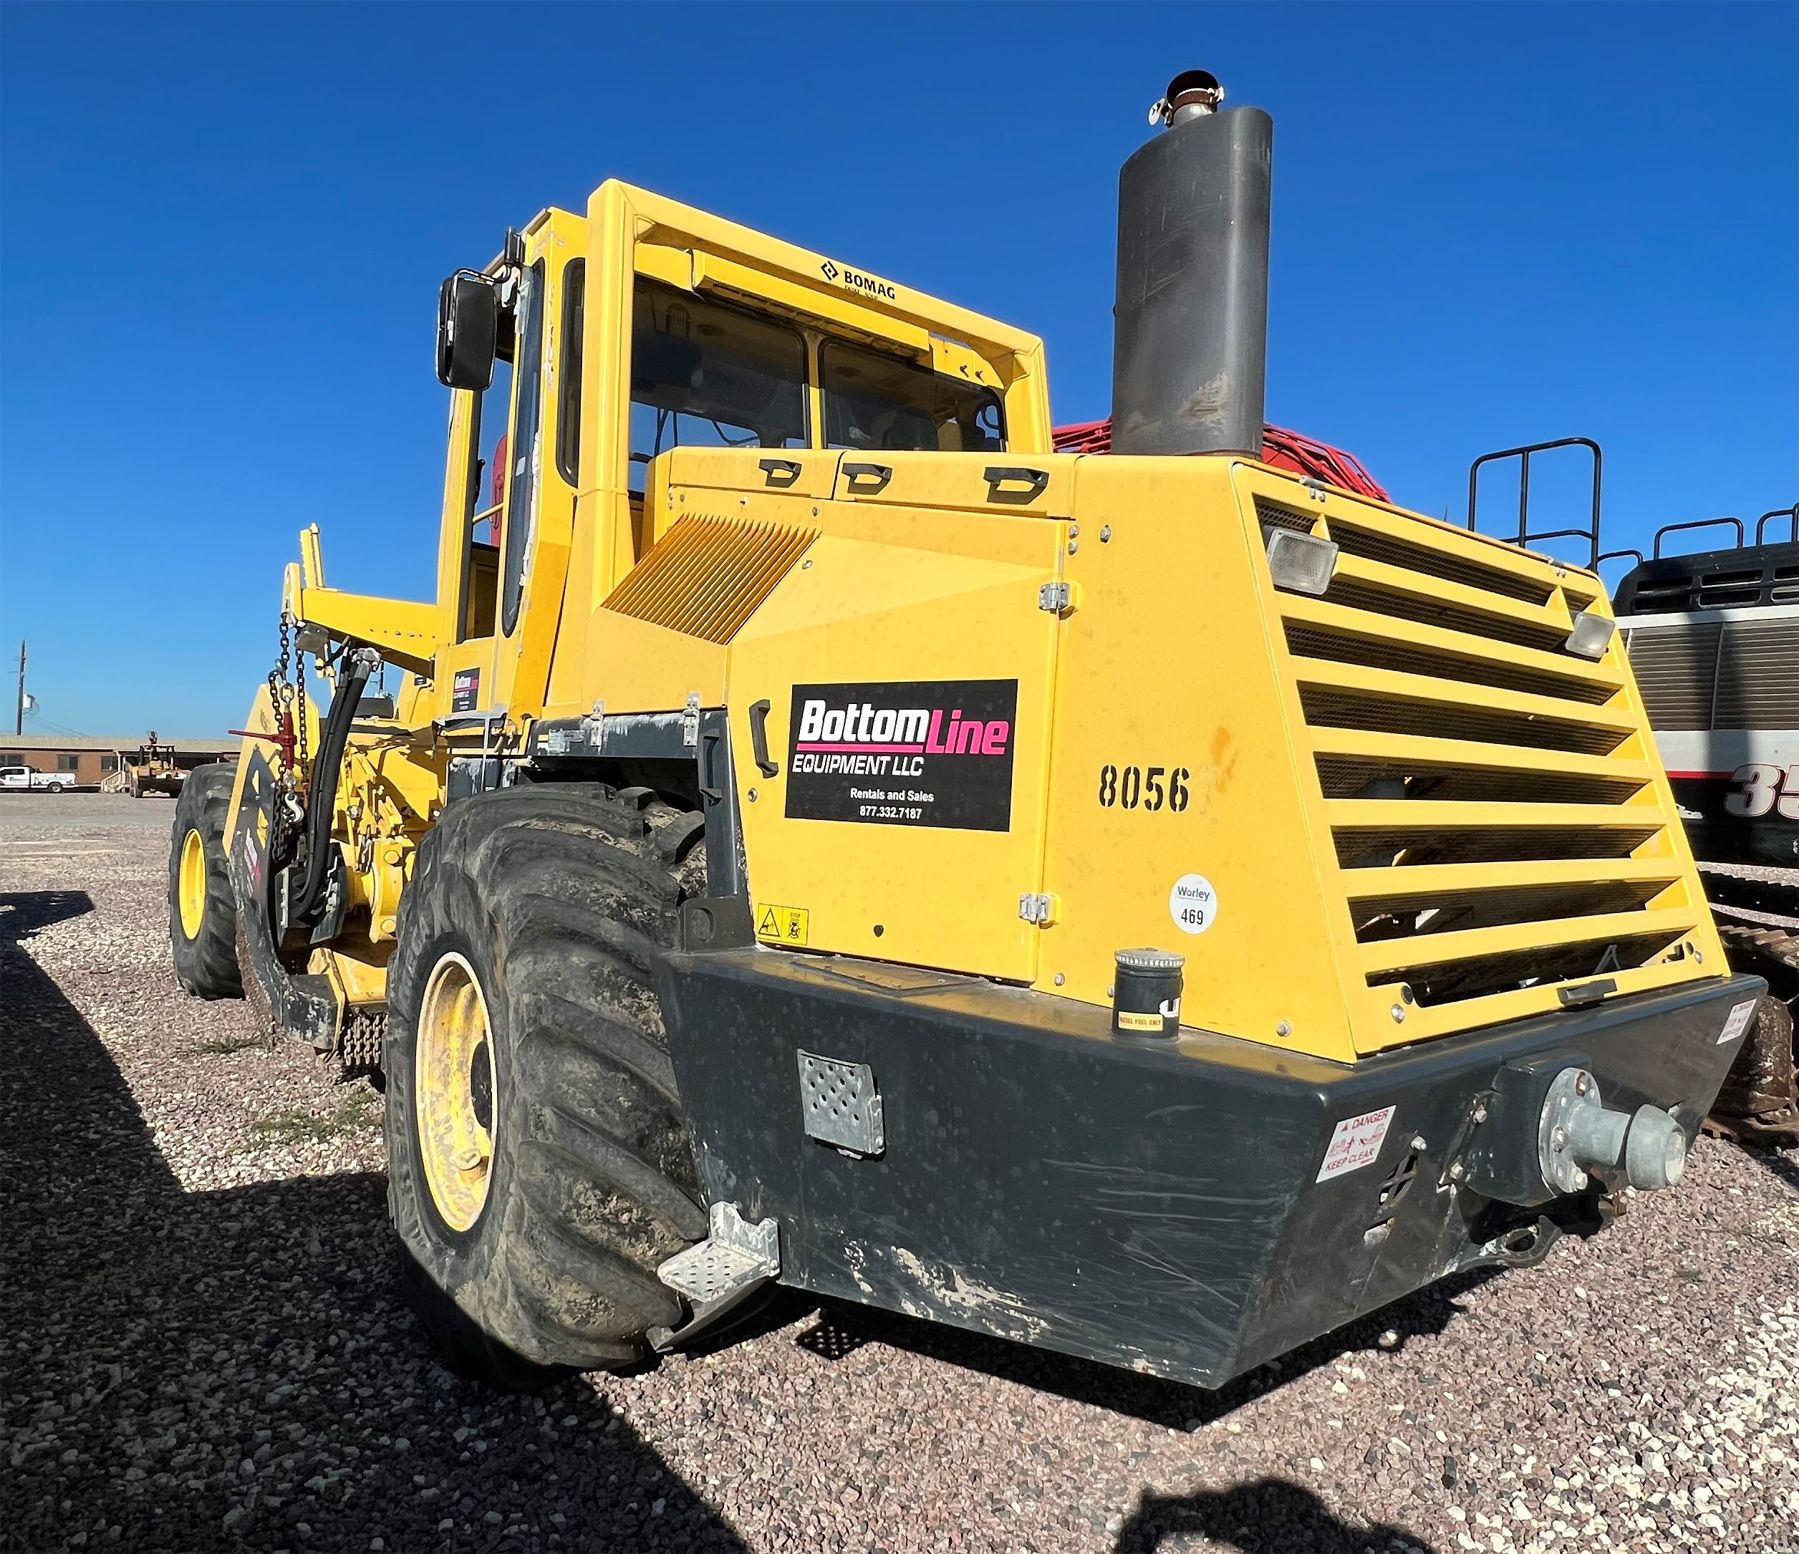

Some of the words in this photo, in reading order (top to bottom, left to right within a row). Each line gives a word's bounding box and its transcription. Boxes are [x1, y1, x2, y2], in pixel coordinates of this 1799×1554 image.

[844, 270, 896, 300] BOMAG
[792, 754, 891, 776] EQUIPMENT
[892, 756, 925, 777] LLC
[850, 787, 885, 801] Rentals
[887, 789, 905, 801] and
[907, 789, 934, 803] Sales
[1098, 764, 1190, 813] 8056
[859, 805, 922, 820] 877.332.7187
[1177, 885, 1210, 902] Worley
[1180, 908, 1204, 925] 469
[1352, 1109, 1389, 1130] DANGER
[1326, 1156, 1348, 1172] KEEP
[1348, 1148, 1375, 1164] CLEAR
